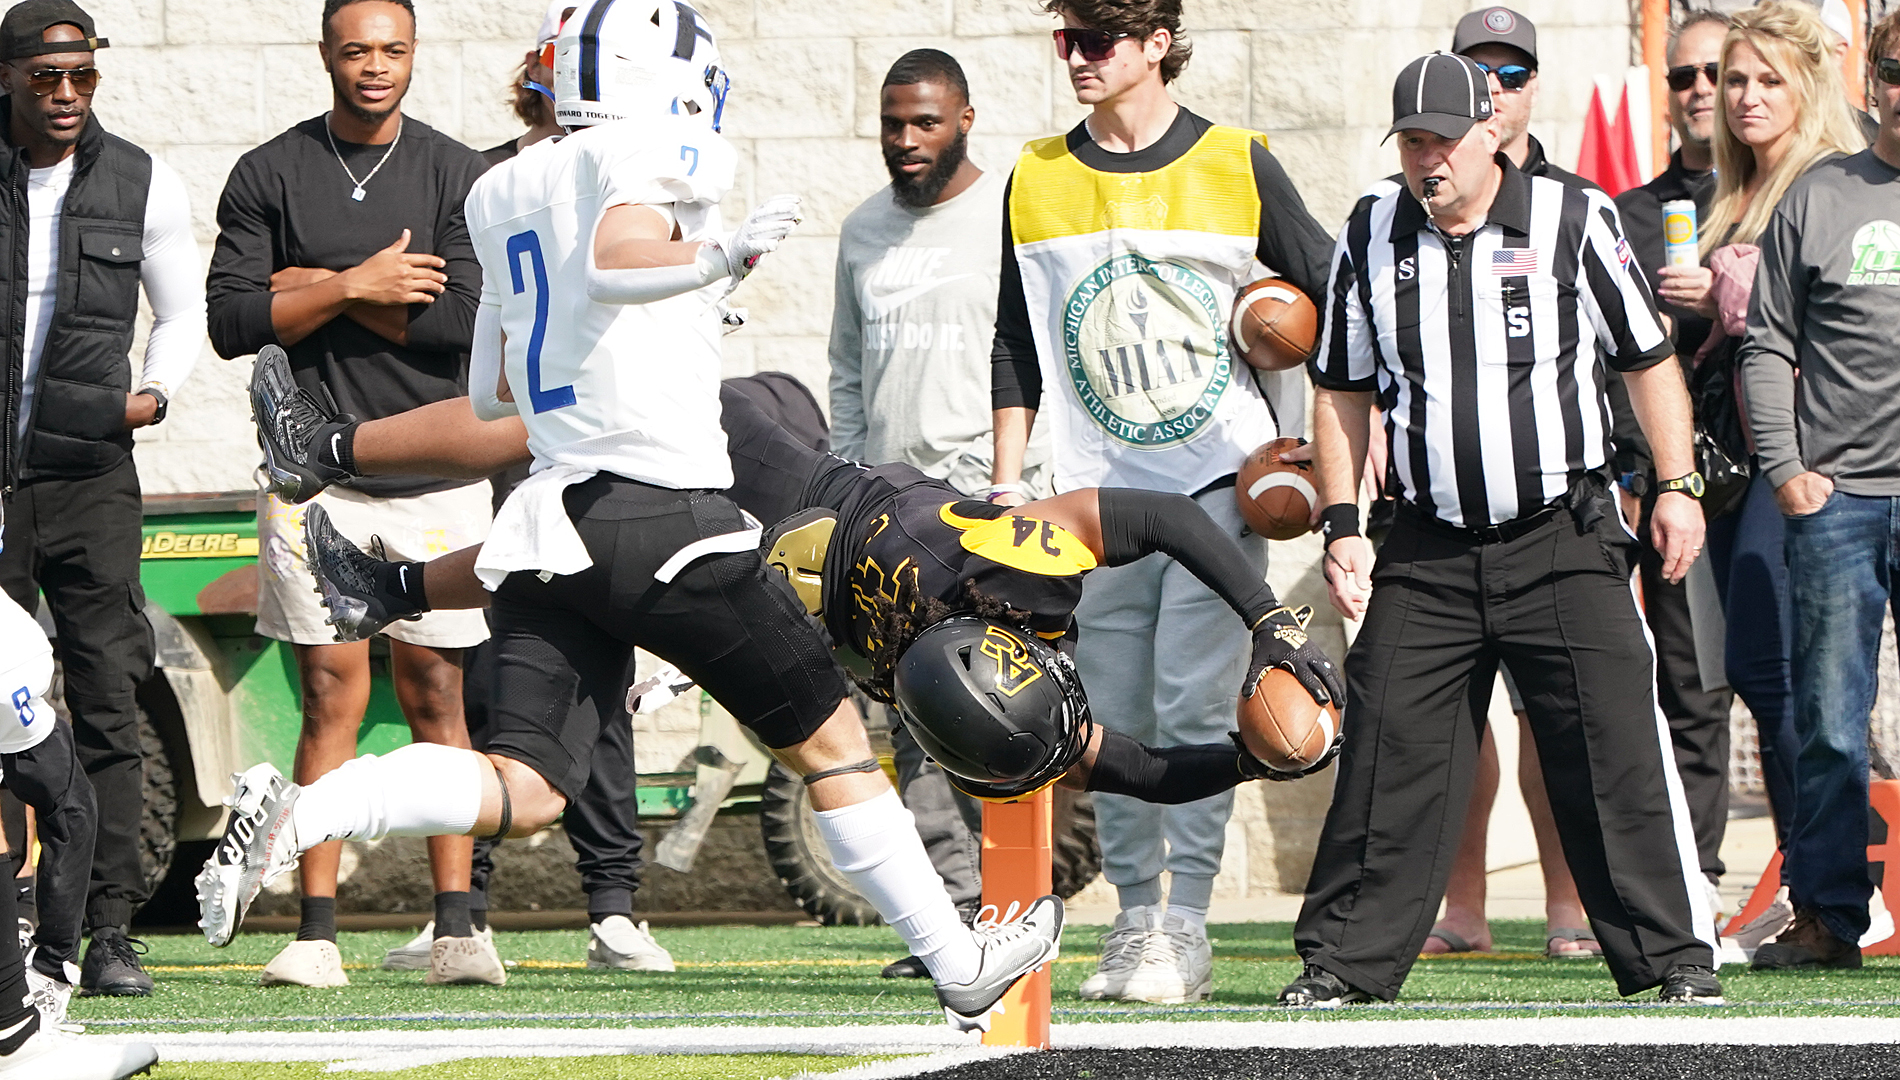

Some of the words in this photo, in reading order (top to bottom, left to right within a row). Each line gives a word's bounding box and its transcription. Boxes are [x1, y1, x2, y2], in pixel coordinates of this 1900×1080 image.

[871, 246, 952, 286] NIKE
[1398, 257, 1415, 280] S
[506, 229, 577, 415] 2
[866, 323, 897, 351] JUST
[903, 321, 934, 350] DO
[941, 322, 966, 351] IT.
[1065, 277, 1100, 370] MICHIGAN
[1507, 306, 1531, 338] S
[1098, 335, 1204, 399] MIAA
[1076, 379, 1147, 441] ATHLETIC
[1151, 343, 1232, 441] ASSOCIATION
[153, 531, 238, 553] DEERE
[1012, 515, 1065, 558] 34
[11, 685, 35, 727] 8
